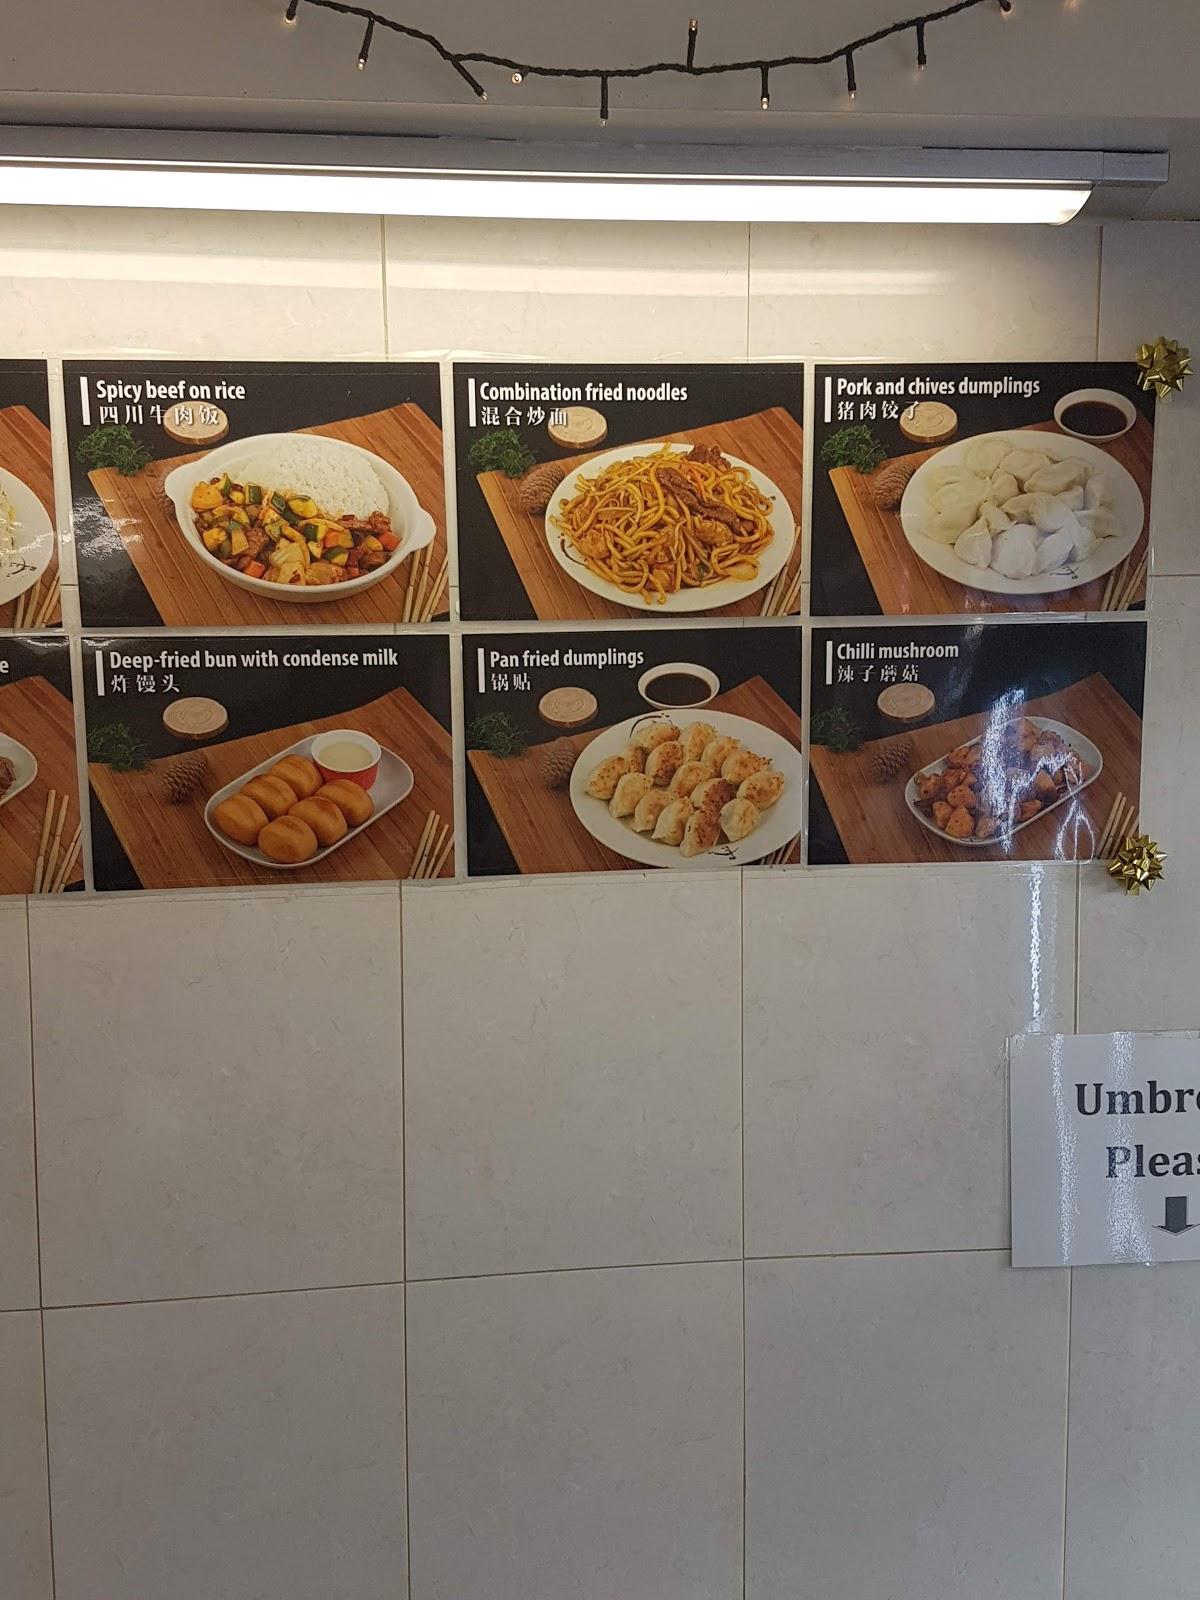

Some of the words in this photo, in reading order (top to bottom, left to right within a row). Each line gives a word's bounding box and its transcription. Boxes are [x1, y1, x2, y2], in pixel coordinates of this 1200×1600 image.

[97, 380, 142, 403] Spicy
[146, 380, 186, 400] beef
[189, 386, 210, 400] on
[215, 381, 246, 400] rice
[480, 382, 582, 401] Combination
[585, 383, 622, 400] fried
[627, 383, 687, 400] noodles
[838, 378, 872, 395] Pork
[875, 378, 904, 395] and
[908, 377, 955, 394] chives
[959, 377, 1039, 398] dumplings
[99, 405, 219, 425] 四川牛肉饭
[481, 406, 567, 426] 混合炒面
[837, 401, 920, 421] 猪肉饺子
[110, 651, 200, 672] Deep-fried
[205, 651, 236, 667] bun
[241, 650, 278, 667] with
[283, 650, 358, 666] condense
[363, 649, 398, 665] milk
[491, 652, 518, 667] Pan
[523, 650, 559, 666] fried
[564, 648, 643, 669] dumplings
[838, 643, 874, 659] Chilli
[879, 642, 958, 658] mushroom
[111, 674, 180, 693] 炸馒头
[491, 673, 531, 691] 锅贴
[838, 664, 919, 683] 辣子蘑菇
[1075, 1080, 1200, 1115] Umbr
[1106, 1144, 1200, 1178] Plea
